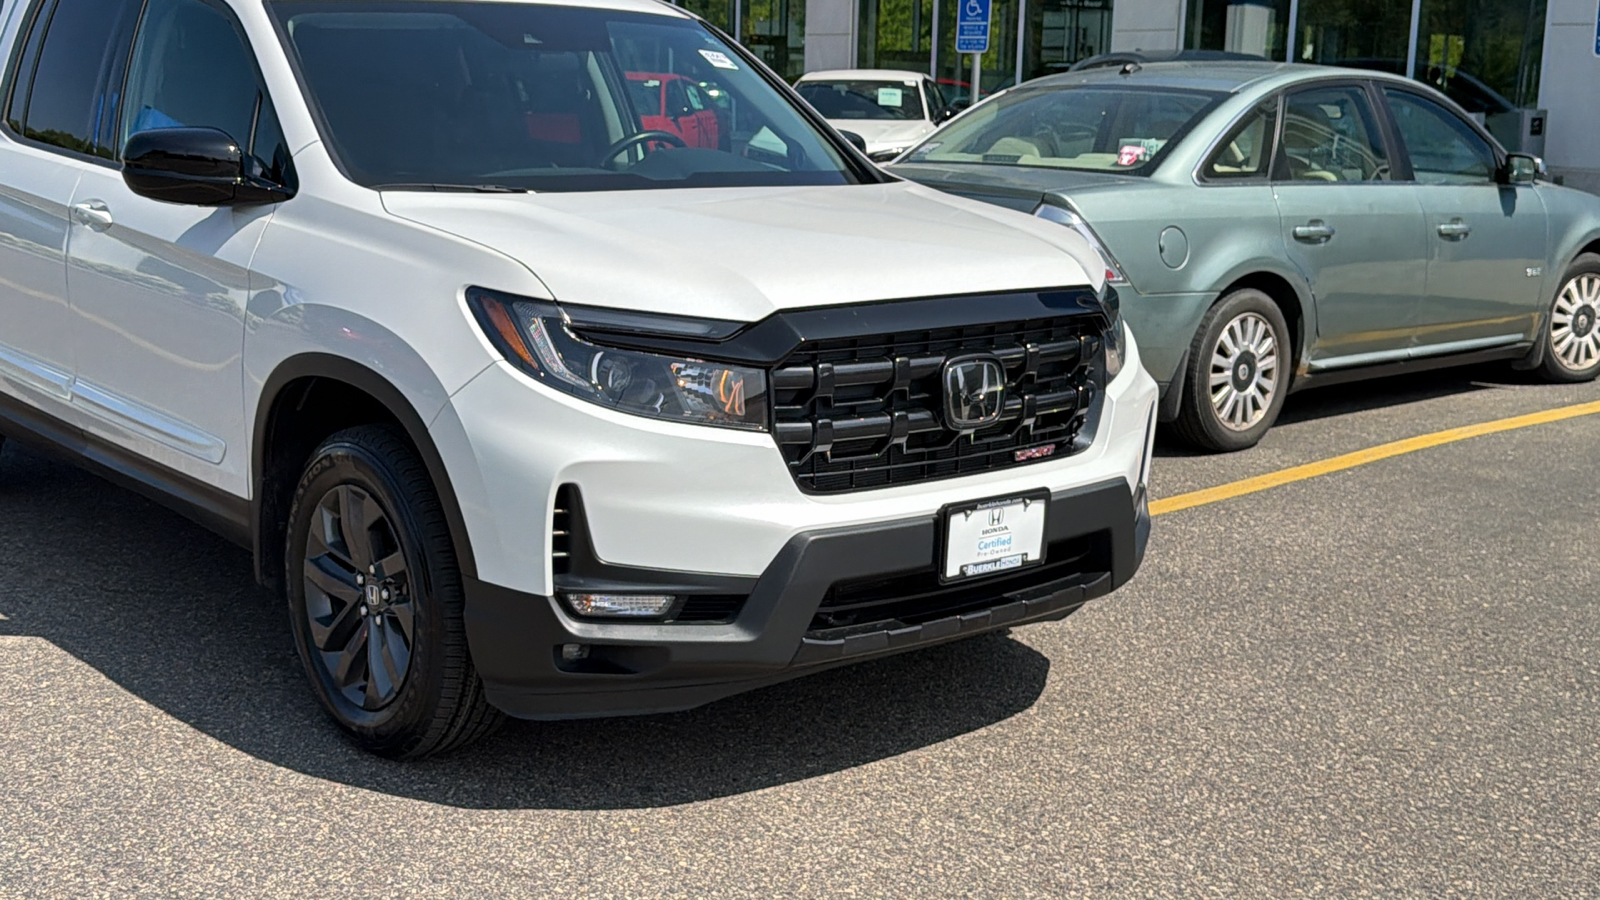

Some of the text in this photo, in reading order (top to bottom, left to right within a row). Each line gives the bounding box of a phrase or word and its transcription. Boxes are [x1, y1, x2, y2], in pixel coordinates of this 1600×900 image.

[981, 525, 1009, 535] HONDA
[977, 535, 1012, 551] Certified
[976, 547, 1012, 557] Pre-Owned
